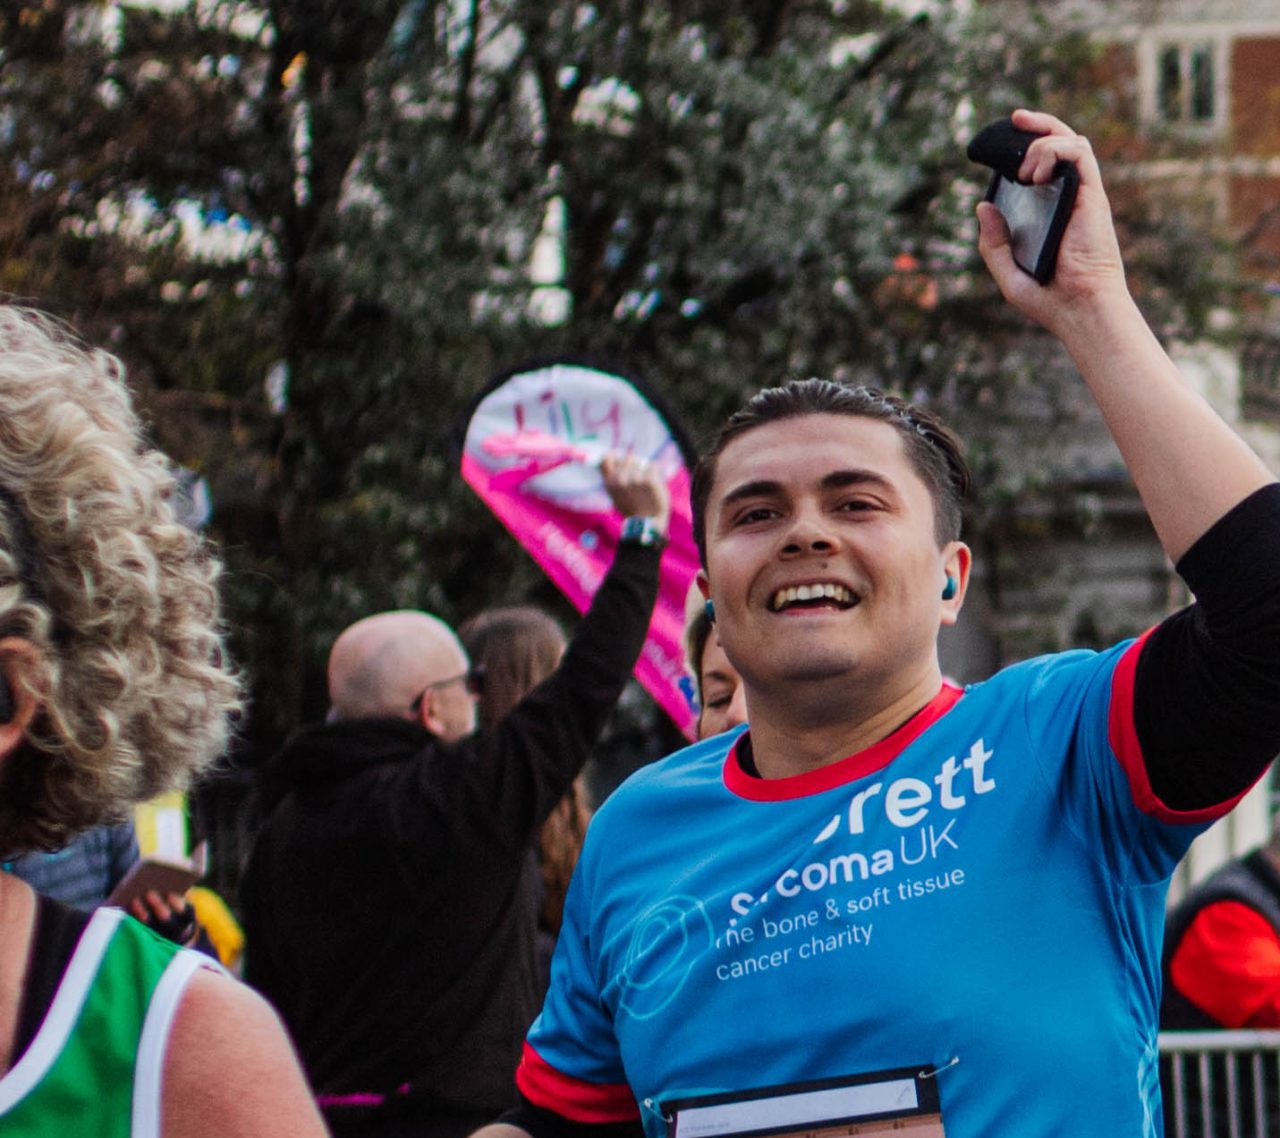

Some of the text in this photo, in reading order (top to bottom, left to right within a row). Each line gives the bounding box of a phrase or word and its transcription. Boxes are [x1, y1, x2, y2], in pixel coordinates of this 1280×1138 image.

[812, 738, 997, 845] rett
[762, 908, 820, 939] bone
[824, 897, 842, 921] &
[847, 887, 891, 914] soft
[897, 867, 966, 901] tissue
[715, 923, 874, 982] cancer charity
